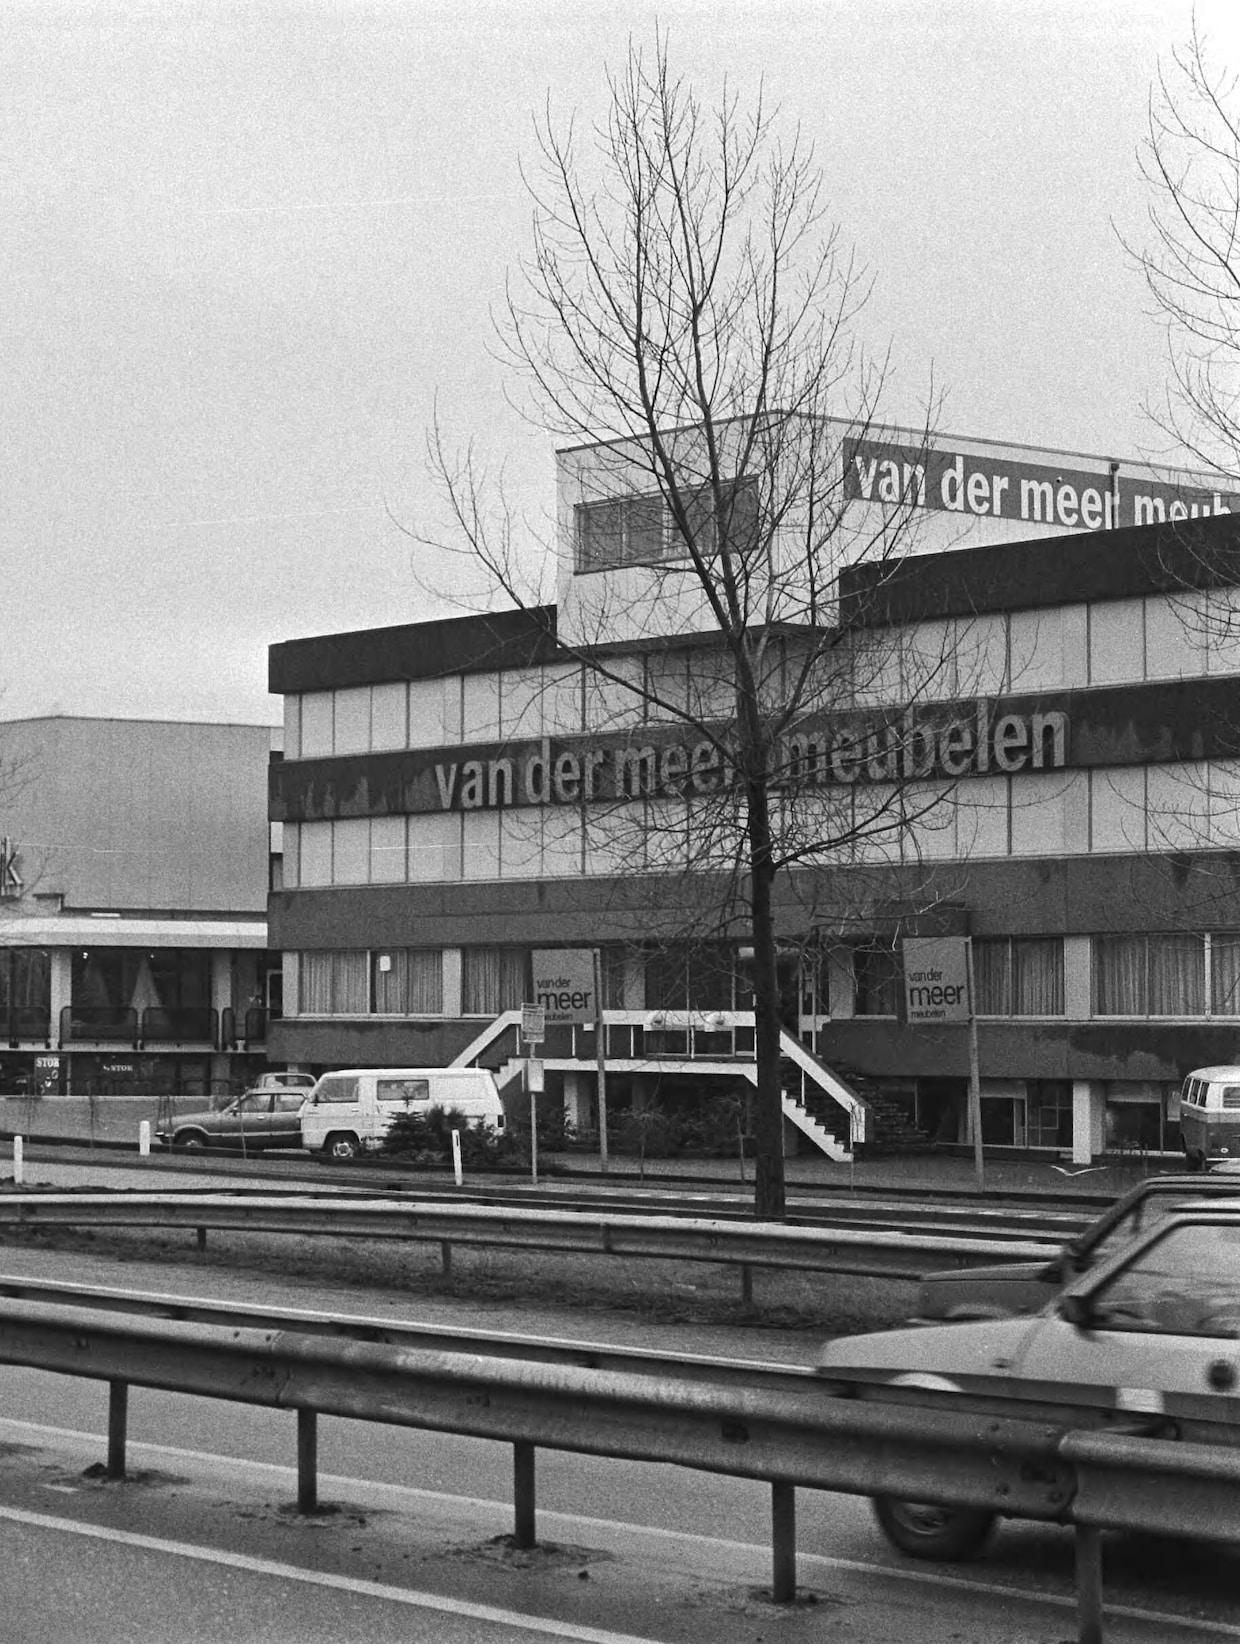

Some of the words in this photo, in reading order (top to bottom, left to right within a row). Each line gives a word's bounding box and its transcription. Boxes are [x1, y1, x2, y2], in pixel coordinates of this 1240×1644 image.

[855, 455, 927, 505] van
[941, 455, 1009, 516] der
[1020, 477, 1121, 530] meer
[435, 757, 512, 809] van
[525, 738, 604, 803] der
[781, 701, 1066, 783] meubelen
[908, 972, 926, 981] van
[927, 968, 943, 981] der
[538, 991, 592, 1010] meer
[910, 985, 965, 1006] meer
